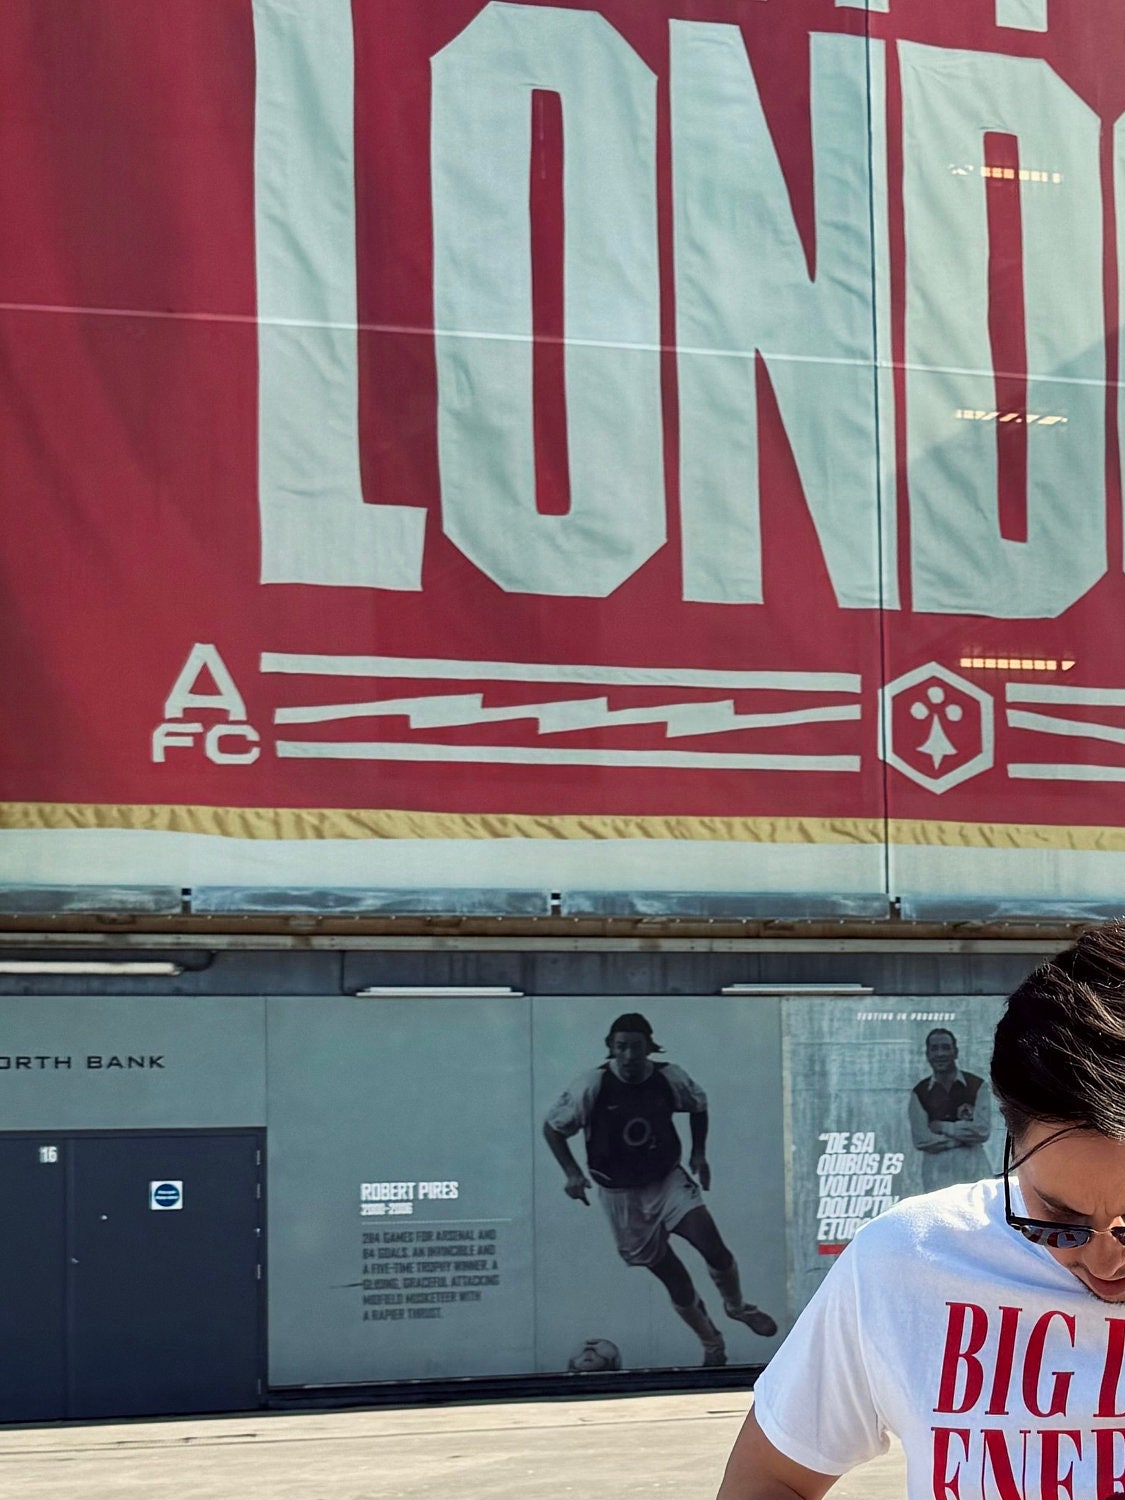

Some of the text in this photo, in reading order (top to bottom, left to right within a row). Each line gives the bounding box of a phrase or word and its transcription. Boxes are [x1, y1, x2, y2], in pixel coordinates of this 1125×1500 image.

[164, 642, 247, 721] A
[152, 722, 260, 765] FC
[87, 1055, 166, 1069] BANK
[850, 1131, 875, 1153] SA
[39, 1146, 58, 1163] 16
[816, 1153, 905, 1175] QUIBUS ES
[360, 1181, 459, 1200] ROBERT PIRES
[818, 1174, 893, 1197] VOLUPTA
[933, 1301, 1076, 1418] BIG
